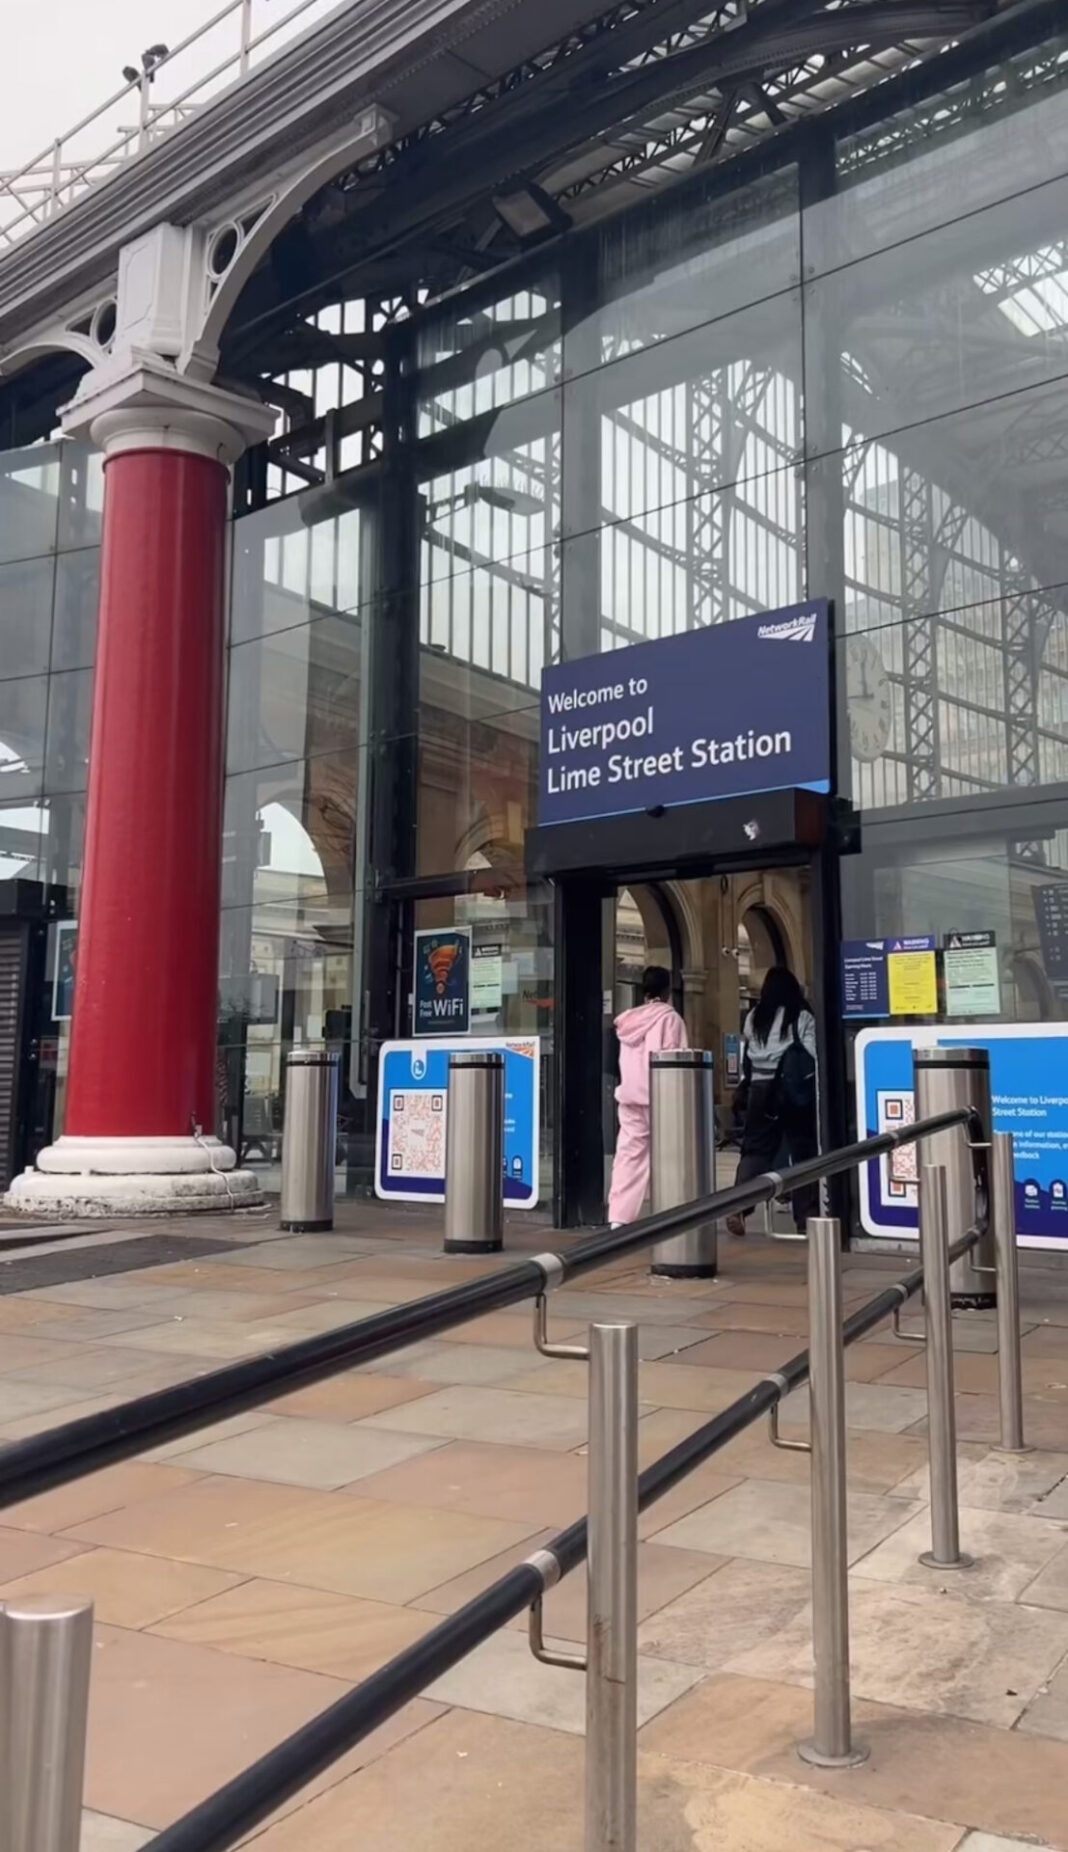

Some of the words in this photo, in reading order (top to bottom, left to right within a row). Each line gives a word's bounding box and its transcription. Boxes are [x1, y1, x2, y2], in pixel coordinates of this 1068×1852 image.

[548, 683, 624, 714] Welcome
[628, 677, 648, 696] to
[548, 706, 654, 754] Liverpool
[548, 766, 601, 794] Lime
[608, 746, 684, 783] Street
[691, 730, 792, 768] Station
[433, 998, 464, 1017] WiFi
[991, 1096, 1028, 1104] Welcome
[992, 1106, 1016, 1116] Street
[1017, 1106, 1047, 1117] Station
